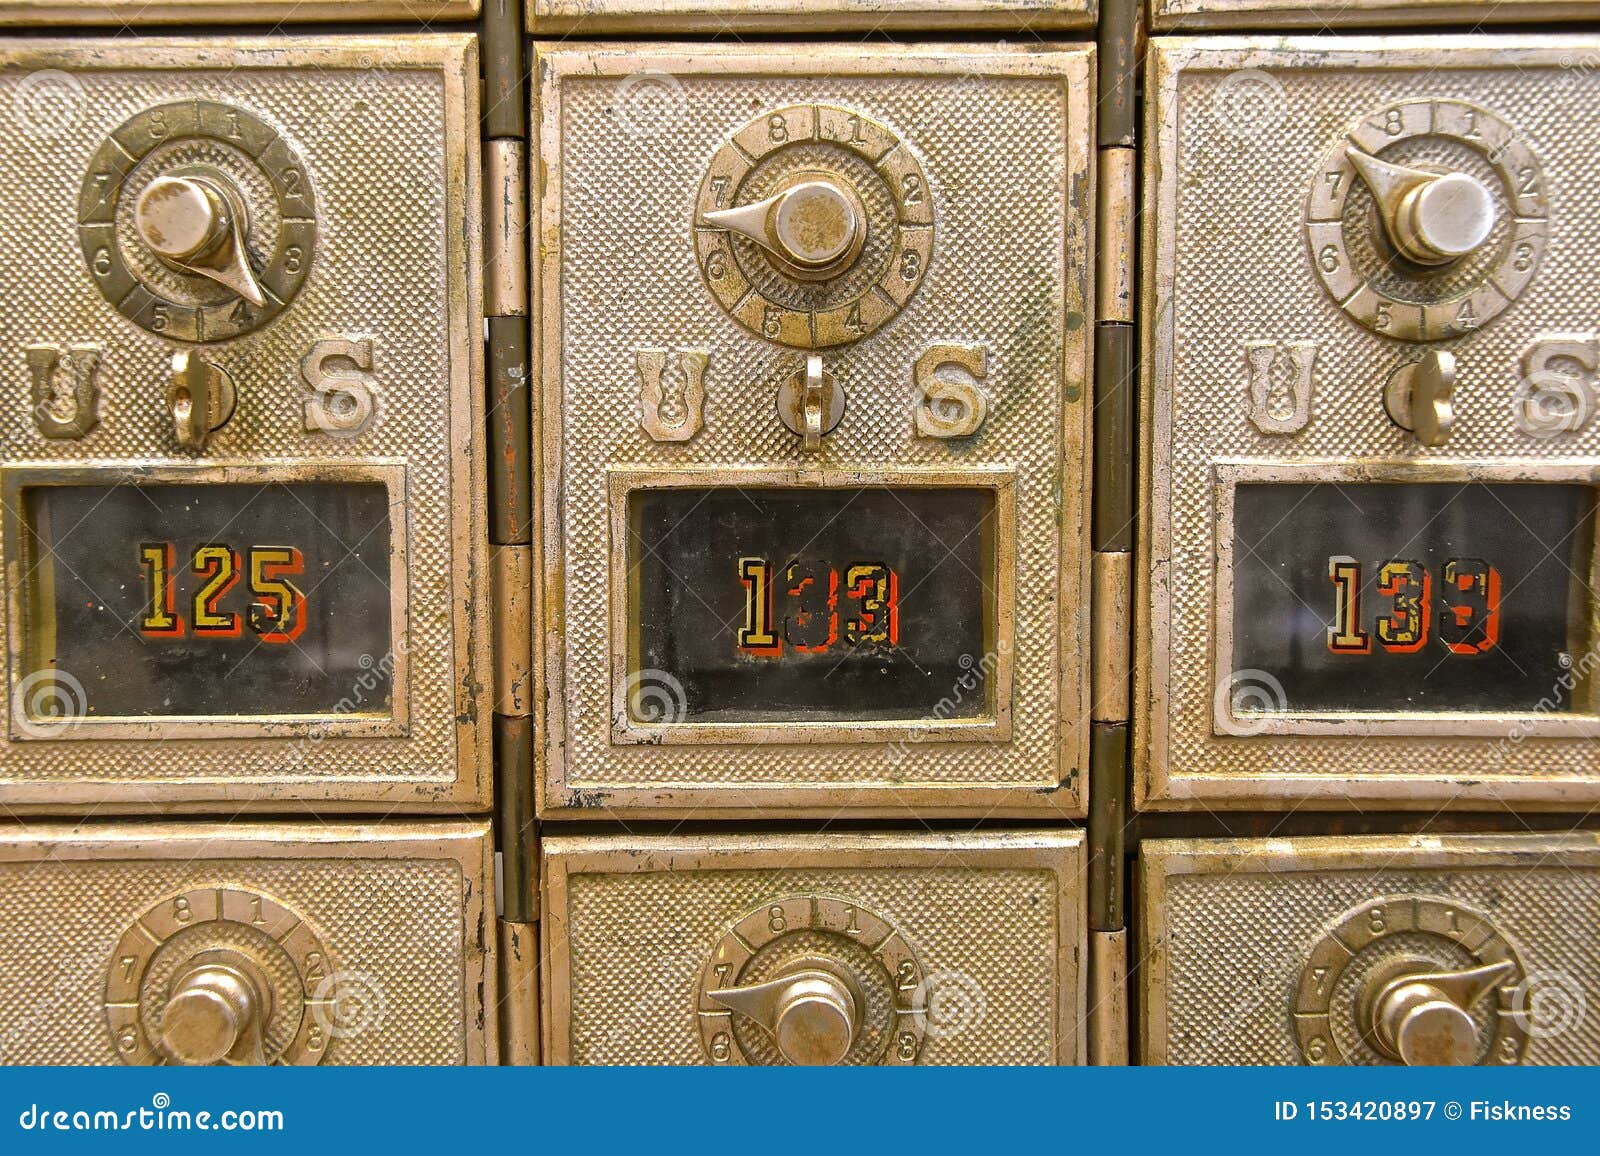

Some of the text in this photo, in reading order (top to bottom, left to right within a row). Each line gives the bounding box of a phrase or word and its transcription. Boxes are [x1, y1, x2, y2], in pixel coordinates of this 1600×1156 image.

[150, 110, 168, 139] 8
[226, 110, 243, 139] 1
[768, 115, 789, 145] 8
[848, 115, 866, 145] 1
[1385, 110, 1403, 137] 8
[1462, 111, 1482, 141] 1
[282, 168, 304, 199] 2
[710, 175, 730, 208] 7
[902, 173, 924, 205] 2
[1325, 171, 1345, 201] 7
[1519, 168, 1539, 198] 2
[94, 248, 112, 277] 6
[284, 248, 302, 276] 3
[706, 249, 727, 281] 6
[901, 249, 922, 281] 3
[1318, 244, 1339, 273] 6
[1512, 243, 1534, 272] 3
[152, 304, 170, 332] 5
[229, 304, 255, 327] 4
[761, 308, 782, 338] 5
[844, 308, 867, 335] 4
[1374, 302, 1394, 330] 5
[1456, 300, 1478, 328] 4
[25, 343, 102, 440] U
[301, 338, 375, 434] S
[637, 343, 989, 442] U S
[1245, 334, 1600, 434] U S
[140, 542, 307, 644] 125
[172, 896, 194, 924] 8
[250, 898, 269, 925] 1
[767, 906, 788, 935] 8
[844, 906, 862, 935] 1
[1368, 908, 1386, 936] 8
[1444, 910, 1464, 936] 1
[118, 954, 139, 985] 7
[303, 952, 326, 985] 2
[712, 961, 734, 990] 7
[896, 959, 919, 992] 2
[117, 1023, 139, 1054] 6
[305, 1025, 324, 1054] 3
[710, 1032, 732, 1062] 6
[896, 1032, 918, 1062] 3
